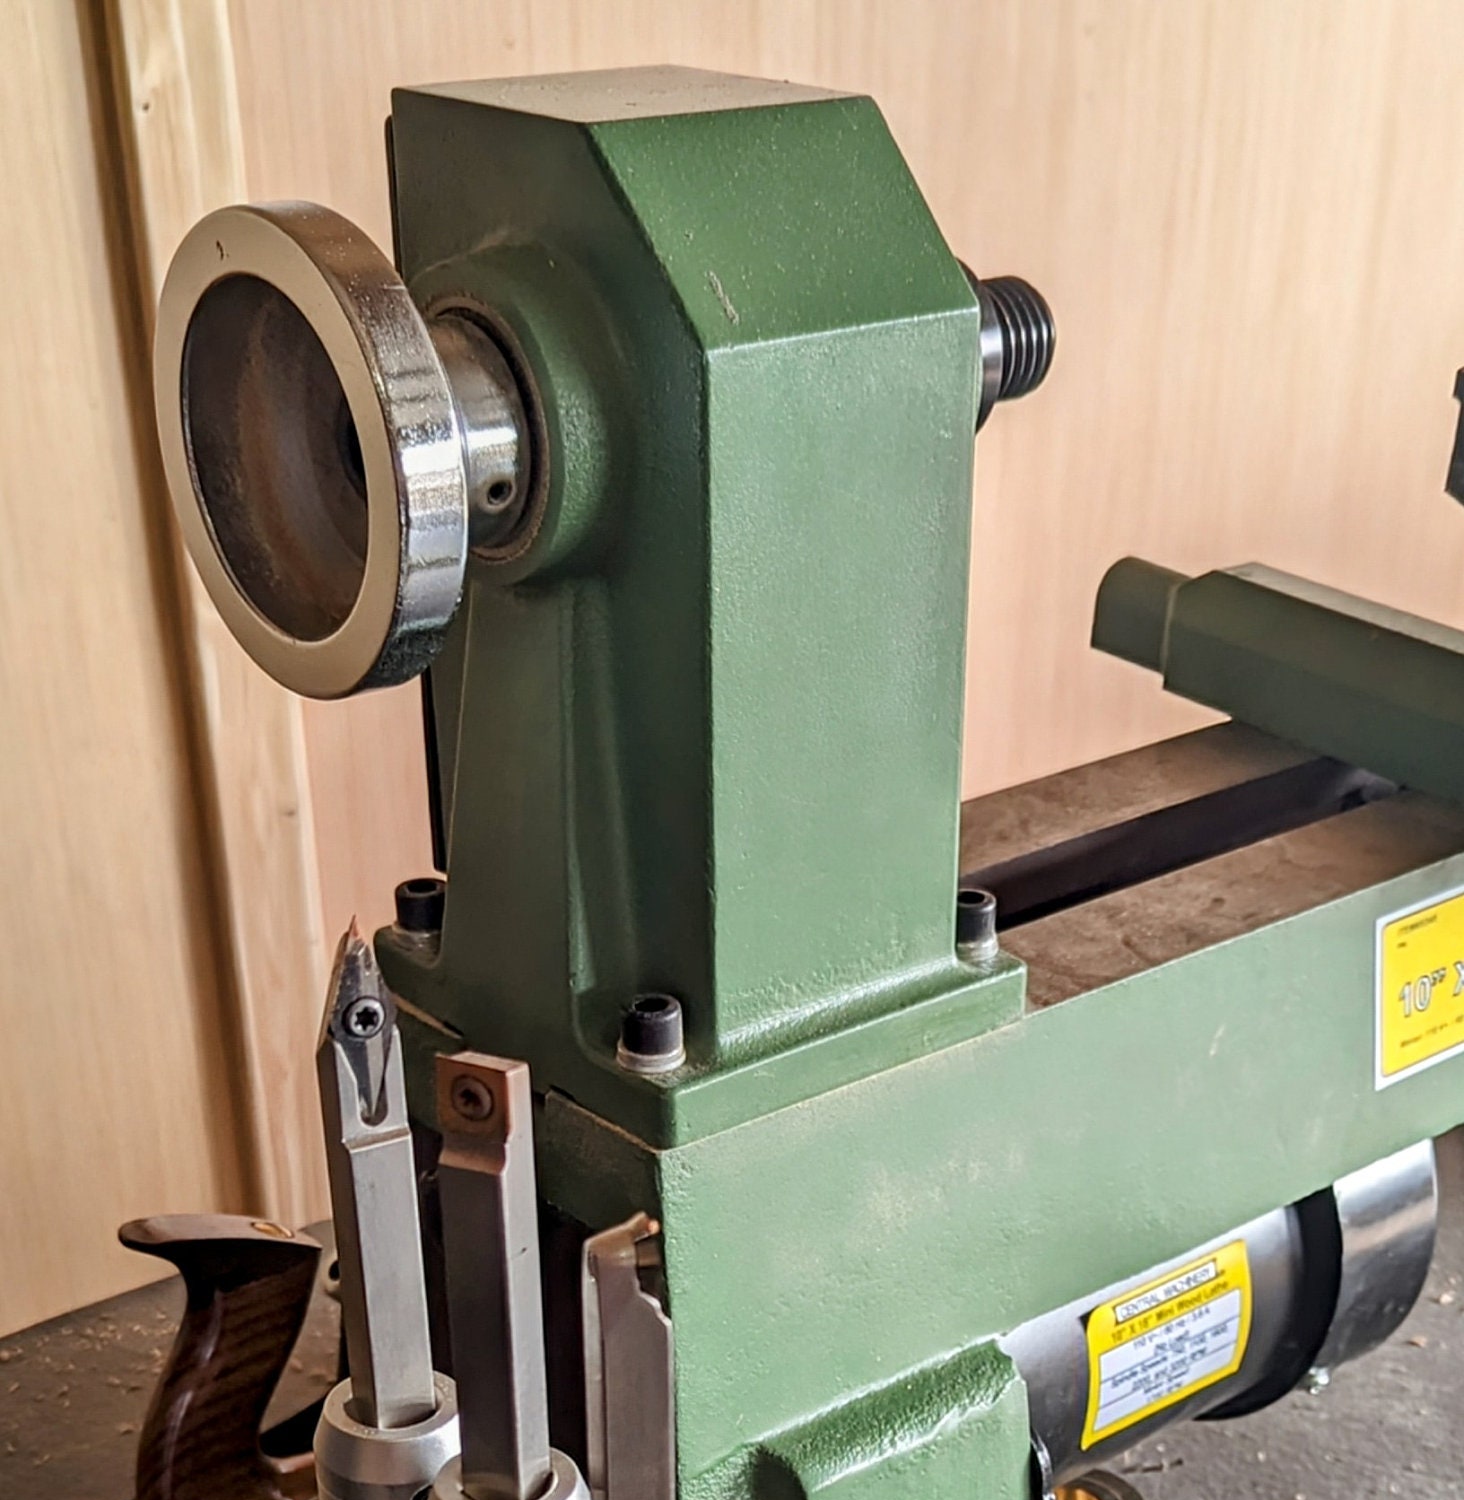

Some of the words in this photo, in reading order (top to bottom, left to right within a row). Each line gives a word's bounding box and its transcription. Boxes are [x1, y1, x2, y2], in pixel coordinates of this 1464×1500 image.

[1120, 1293, 1158, 1318] CENTRAL
[1163, 1267, 1210, 1297] MACHINERY
[1156, 1306, 1175, 1321] Mini
[1177, 1293, 1203, 1311] Wood
[1204, 1281, 1229, 1299] Lathe
